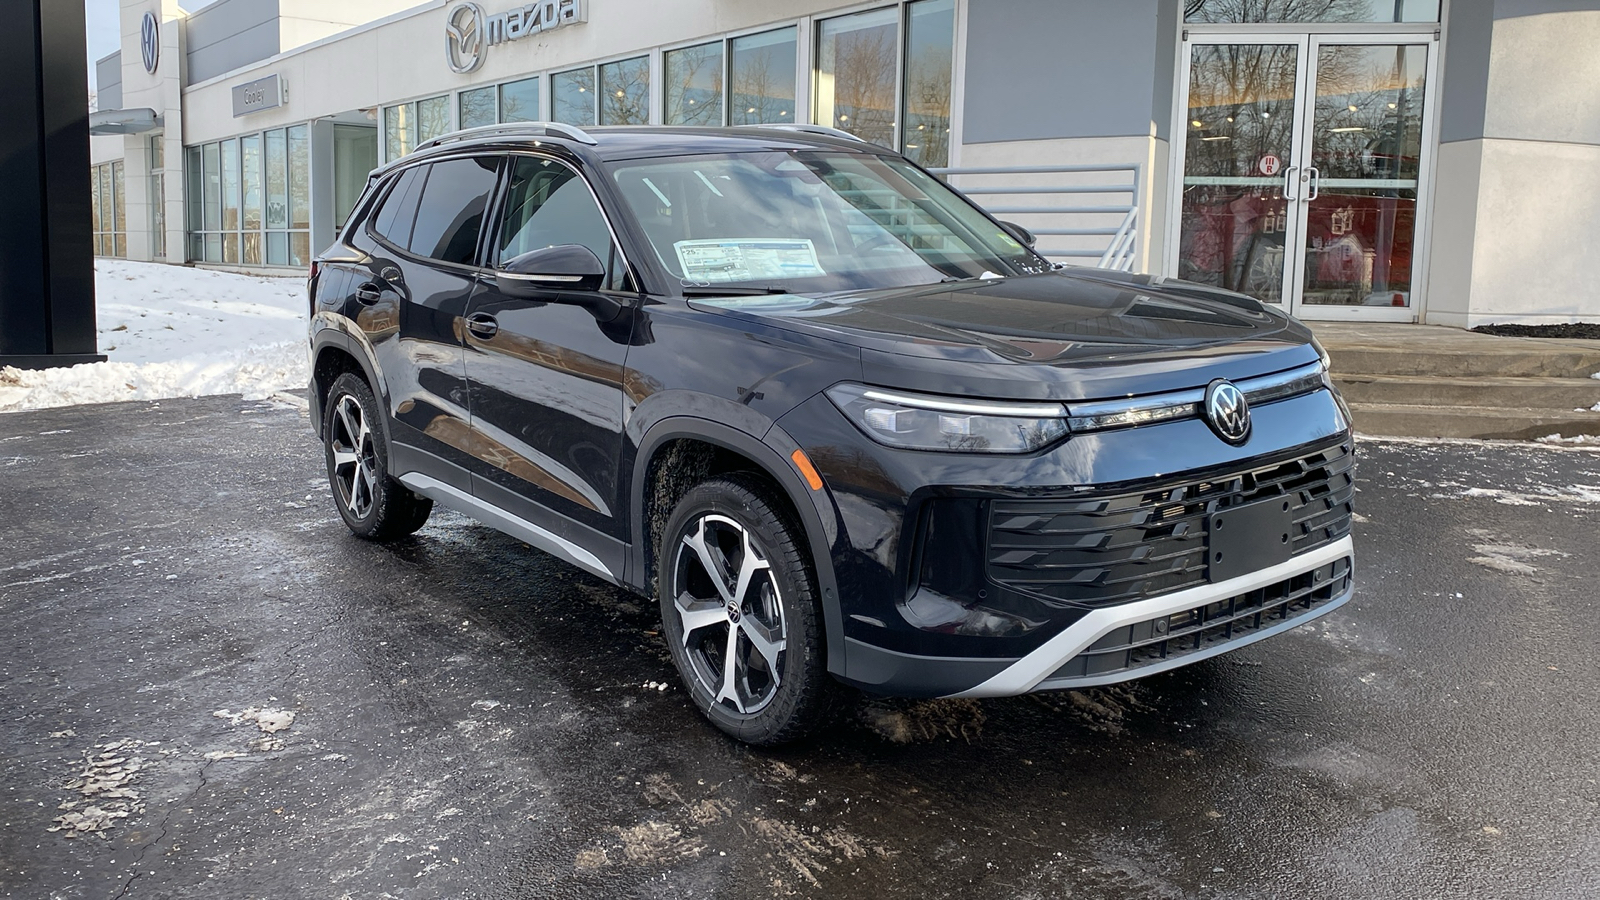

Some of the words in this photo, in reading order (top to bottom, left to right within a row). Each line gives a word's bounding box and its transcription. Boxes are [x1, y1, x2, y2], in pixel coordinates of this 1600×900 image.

[486, 0, 582, 46] mazda
[243, 83, 265, 106] Cooley
[1266, 165, 1273, 173] R
